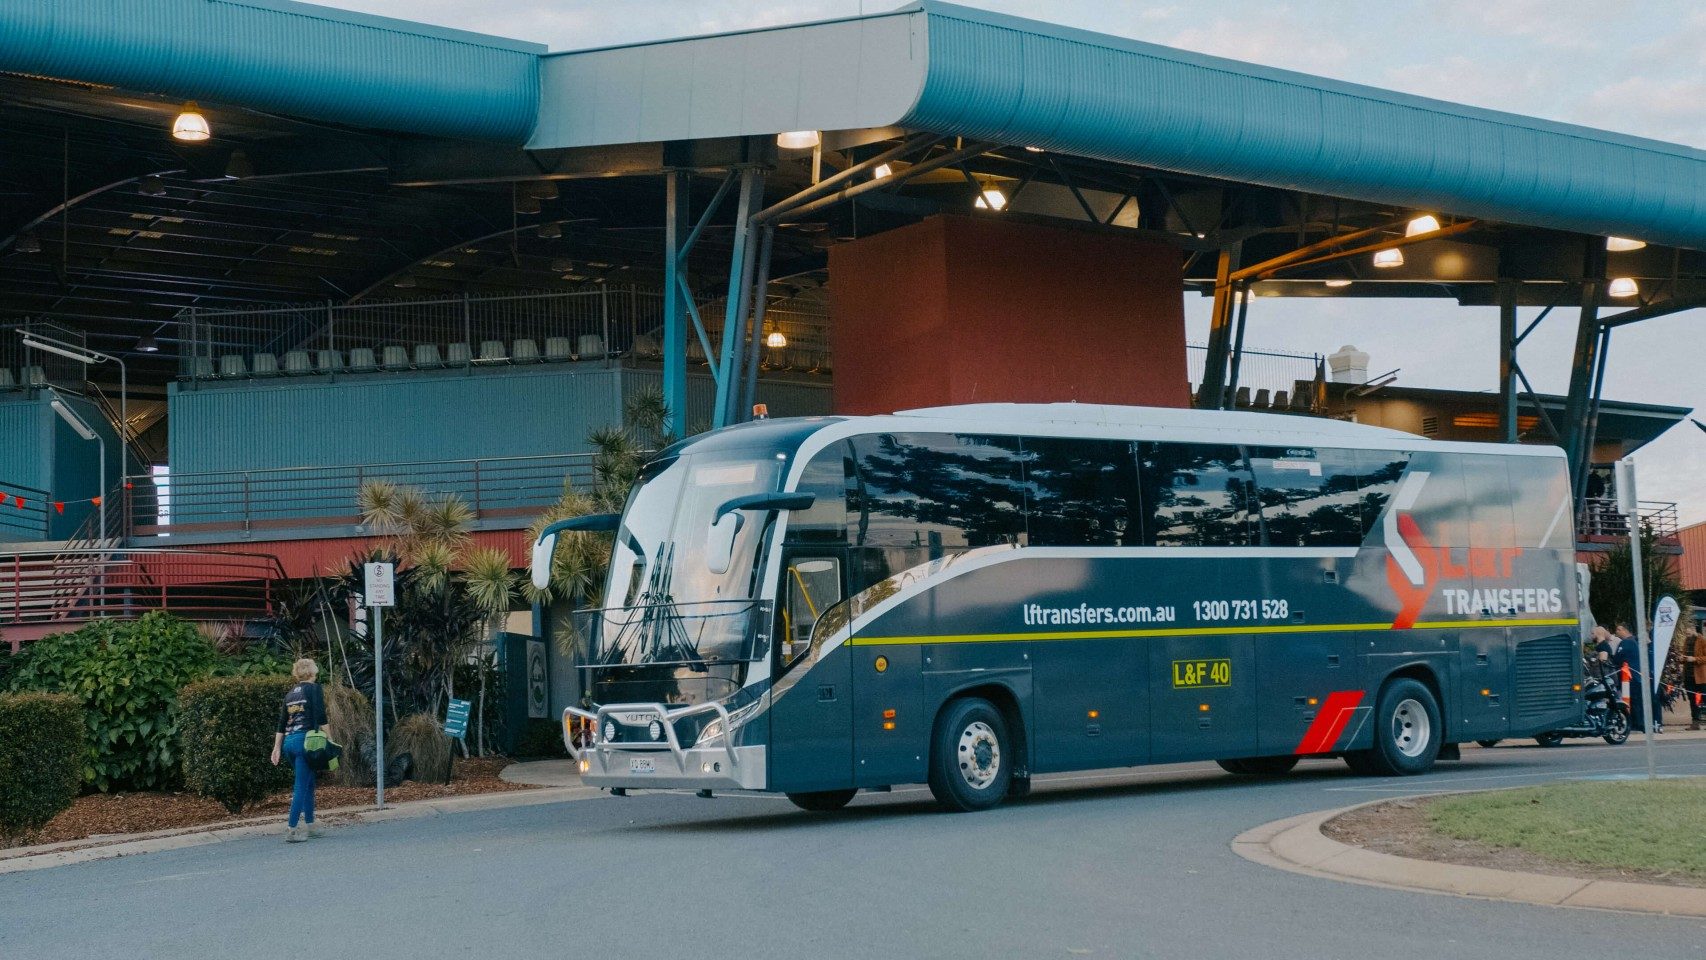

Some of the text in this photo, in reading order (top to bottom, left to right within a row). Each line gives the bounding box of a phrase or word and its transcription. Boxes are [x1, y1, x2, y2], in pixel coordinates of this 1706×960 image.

[1193, 599, 1289, 621] 1300 731 528
[1443, 588, 1562, 615] TRANSFERS
[1024, 603, 1176, 625] lftransfers.com.au
[1174, 662, 1230, 685] L&F 40
[624, 713, 665, 722] YUTON
